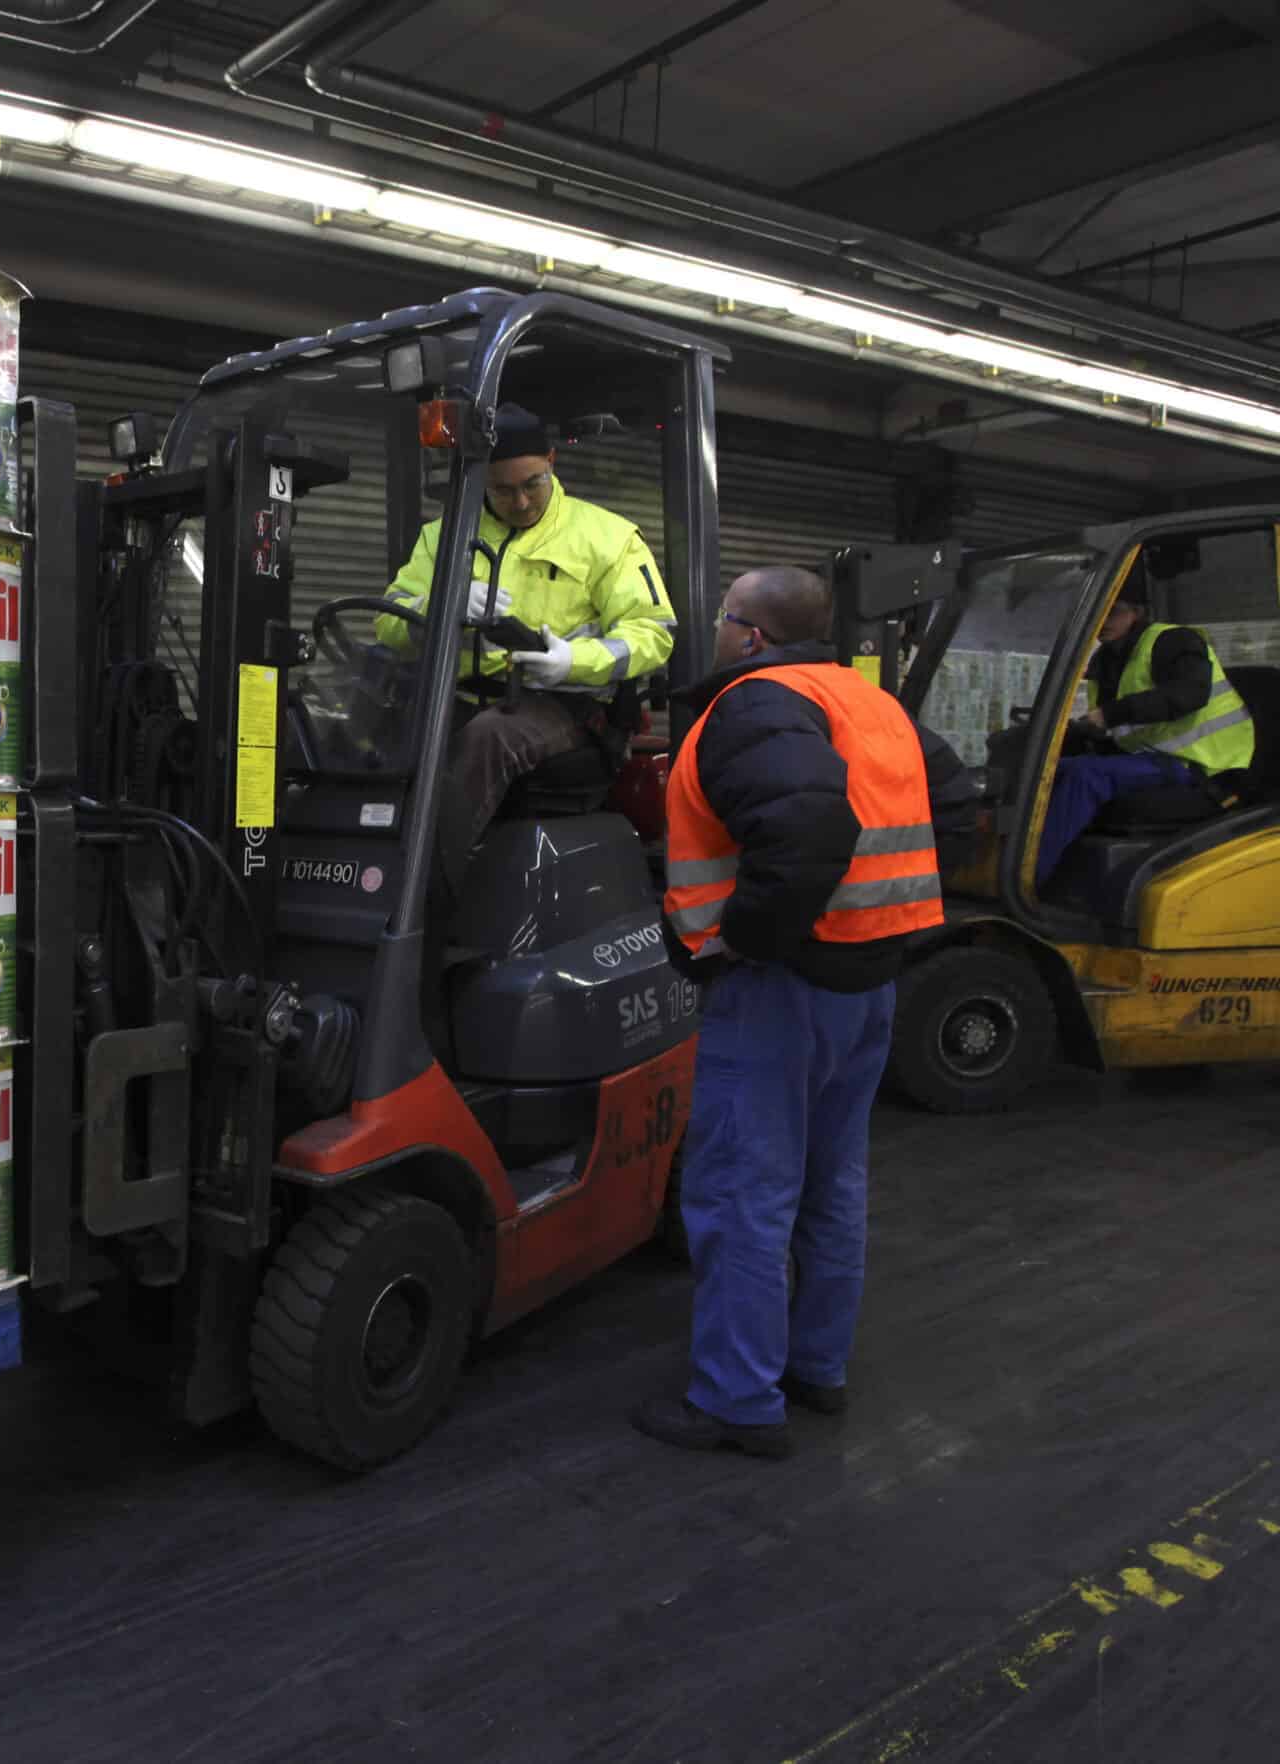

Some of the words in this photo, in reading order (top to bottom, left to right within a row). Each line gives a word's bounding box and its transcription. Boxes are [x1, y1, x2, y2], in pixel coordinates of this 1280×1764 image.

[617, 922, 665, 957] TOYOT
[618, 986, 659, 1029] SAS
[1200, 996, 1251, 1024] 629
